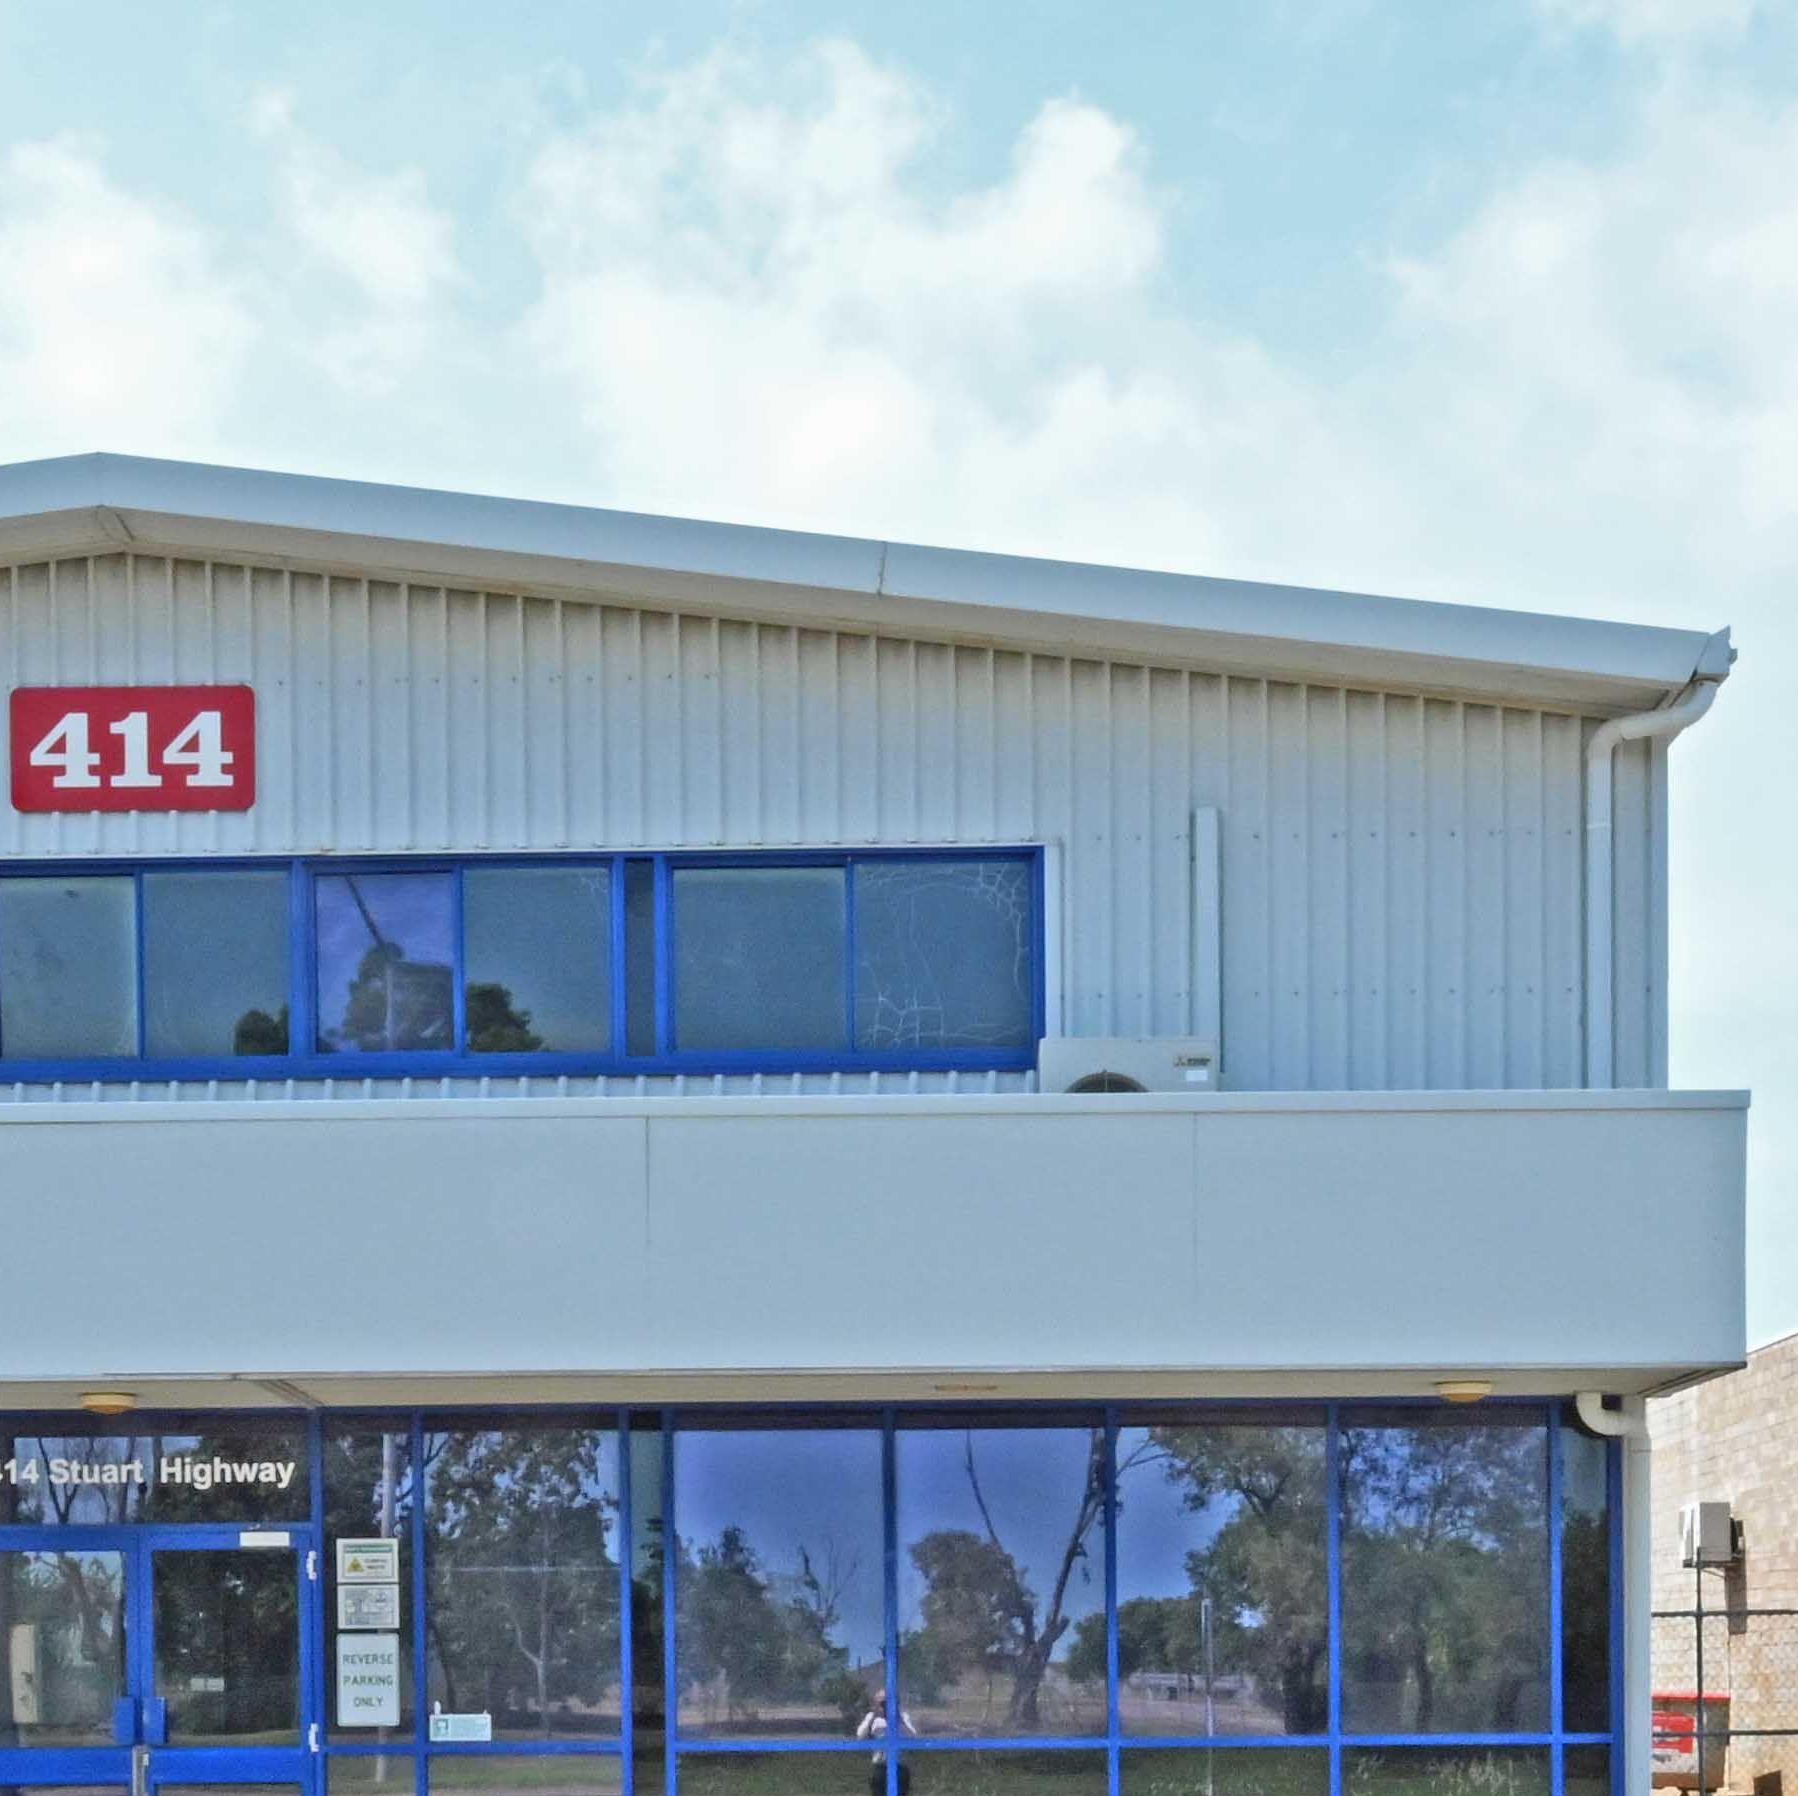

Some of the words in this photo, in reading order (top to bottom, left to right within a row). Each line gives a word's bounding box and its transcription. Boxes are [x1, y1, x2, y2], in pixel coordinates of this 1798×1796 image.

[30, 711, 234, 787] 414
[49, 1459, 144, 1485] Stuart
[160, 1457, 295, 1489] Highway
[343, 1653, 394, 1664] REVERSE
[343, 1675, 394, 1686] PARKING
[353, 1696, 383, 1707] ONLY
